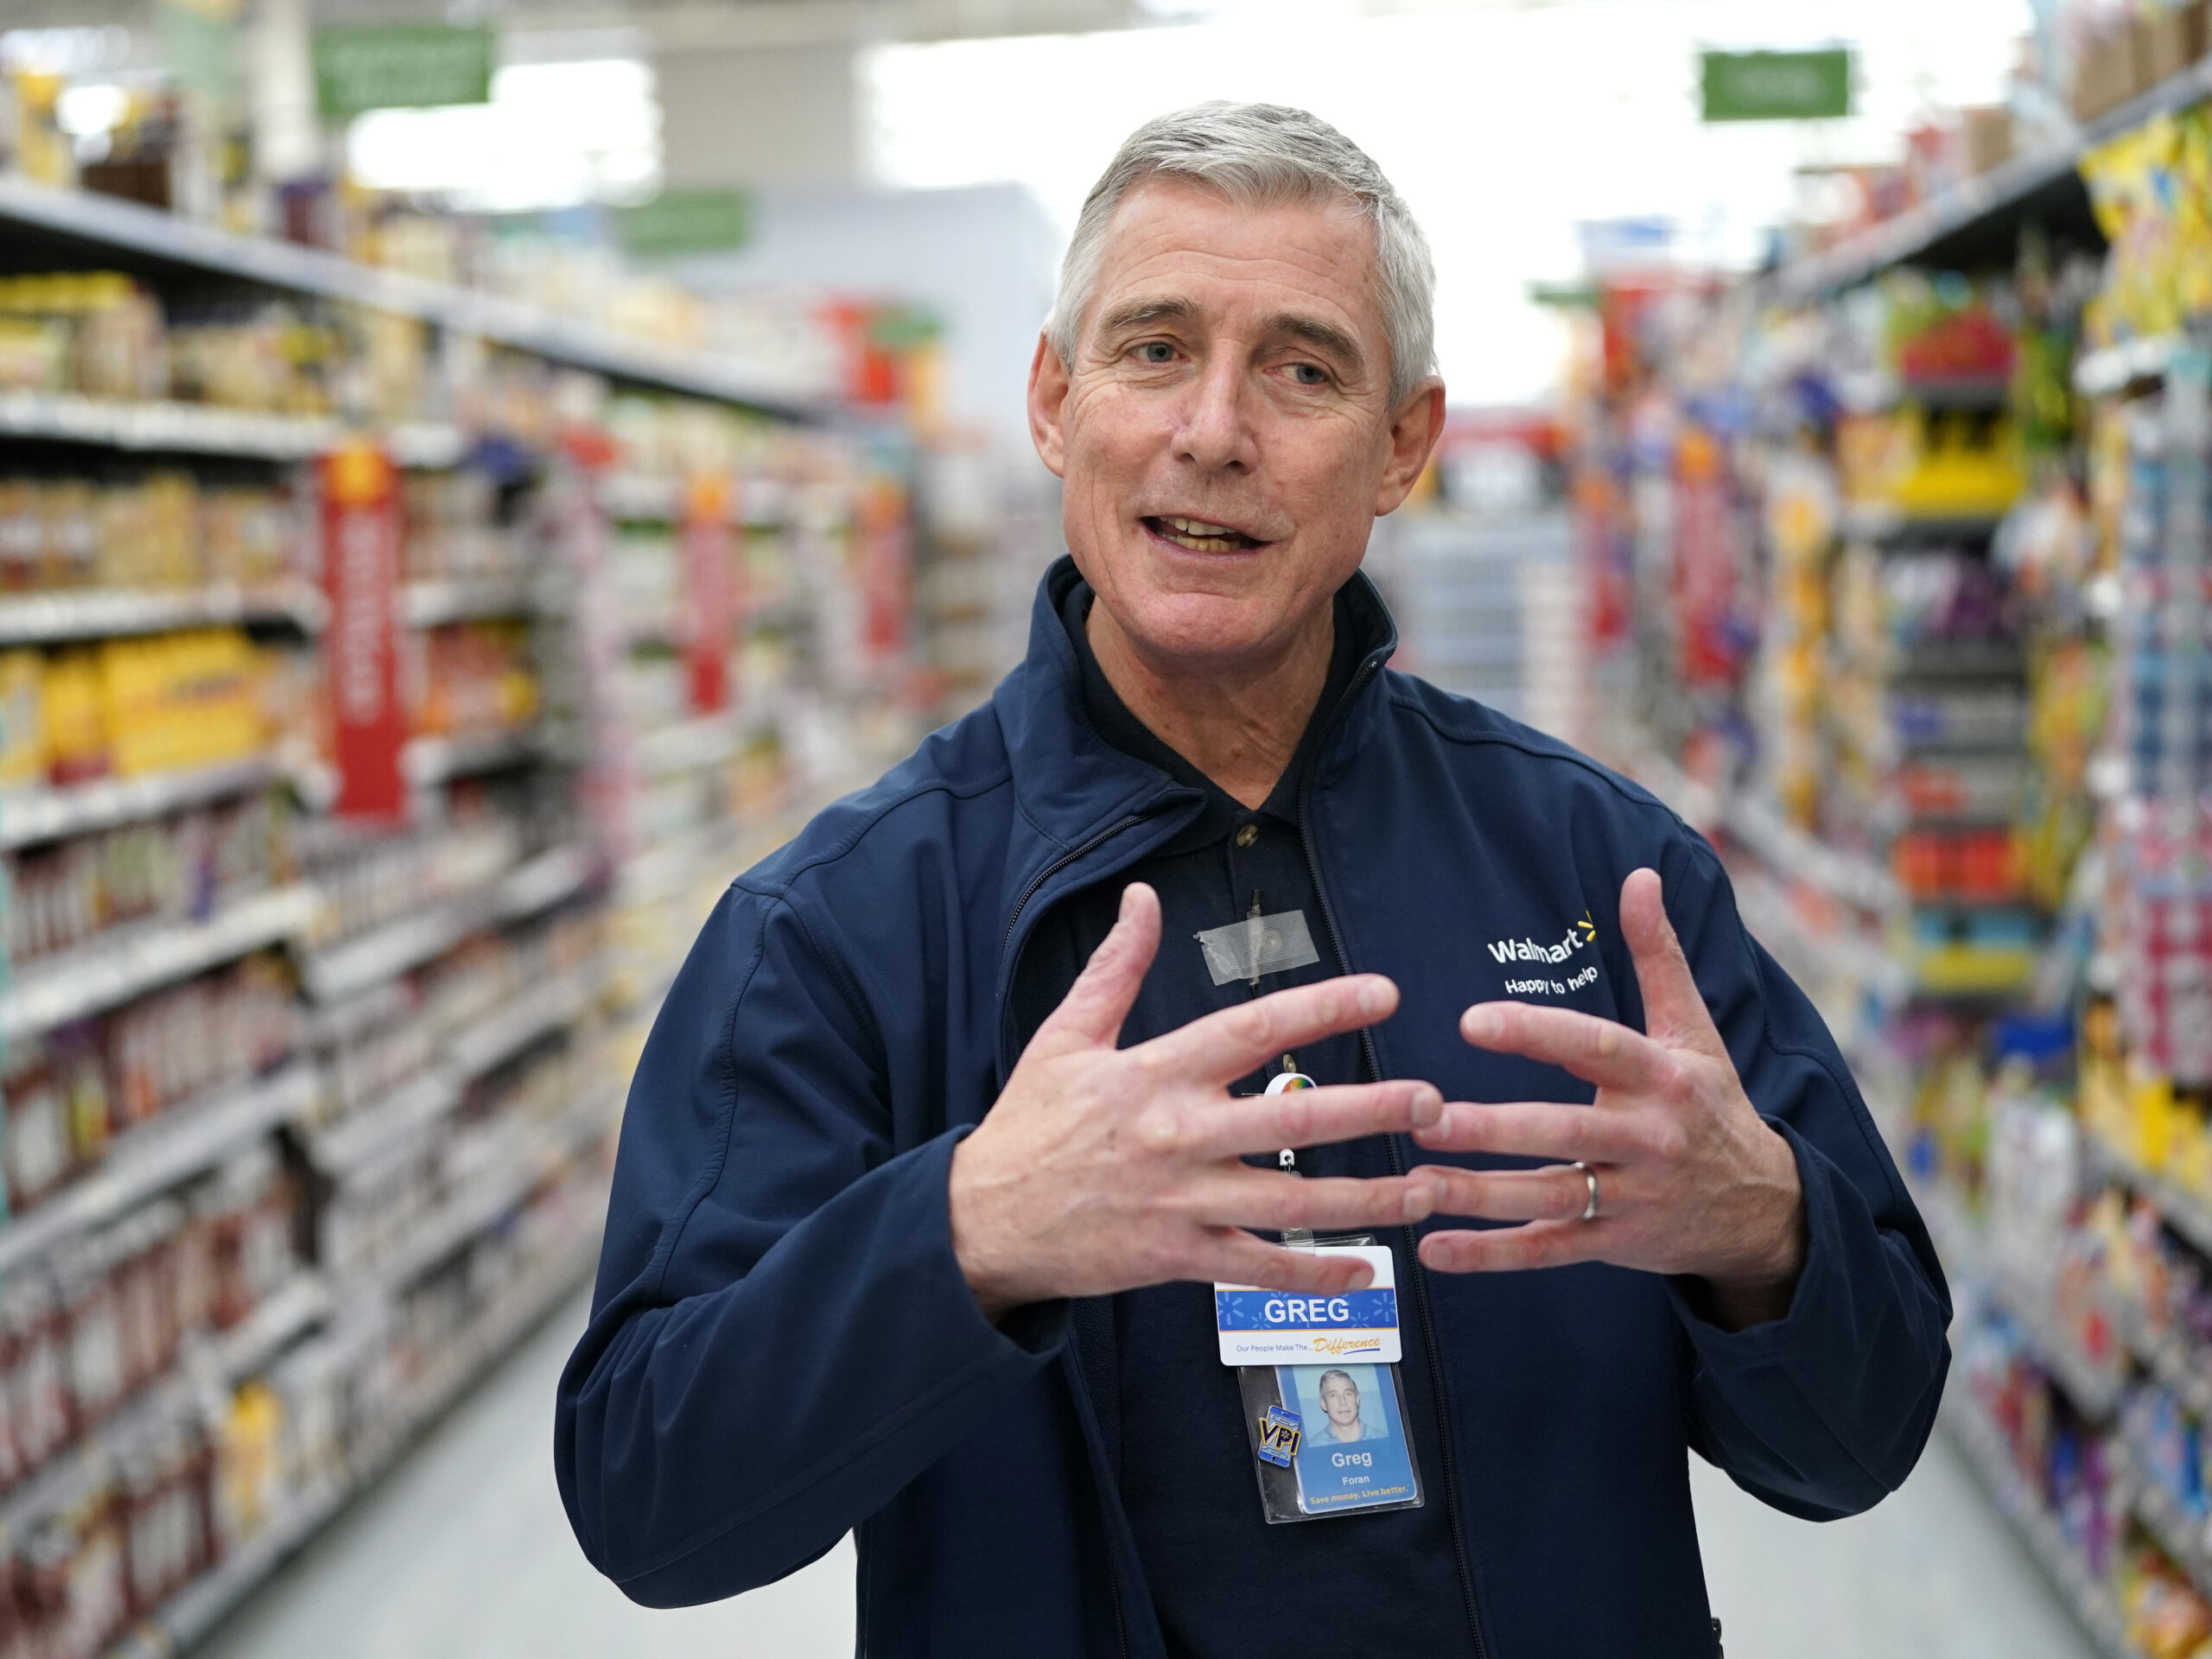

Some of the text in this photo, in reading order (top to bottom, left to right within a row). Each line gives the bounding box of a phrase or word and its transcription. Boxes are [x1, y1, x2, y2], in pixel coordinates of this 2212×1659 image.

[1487, 928, 1584, 964] Walmart
[1504, 966, 1599, 995] Happy to help
[1264, 1298, 1350, 1323] GREG
[1250, 1344, 1274, 1353] People
[1313, 1338, 1381, 1355] Difference
[1259, 1417, 1301, 1455] VPI
[1332, 1452, 1373, 1467] Greg
[1342, 1475, 1370, 1486] Foran
[1310, 1496, 1330, 1505] Save
[1331, 1492, 1361, 1502] money.
[1362, 1488, 1380, 1497] Live
